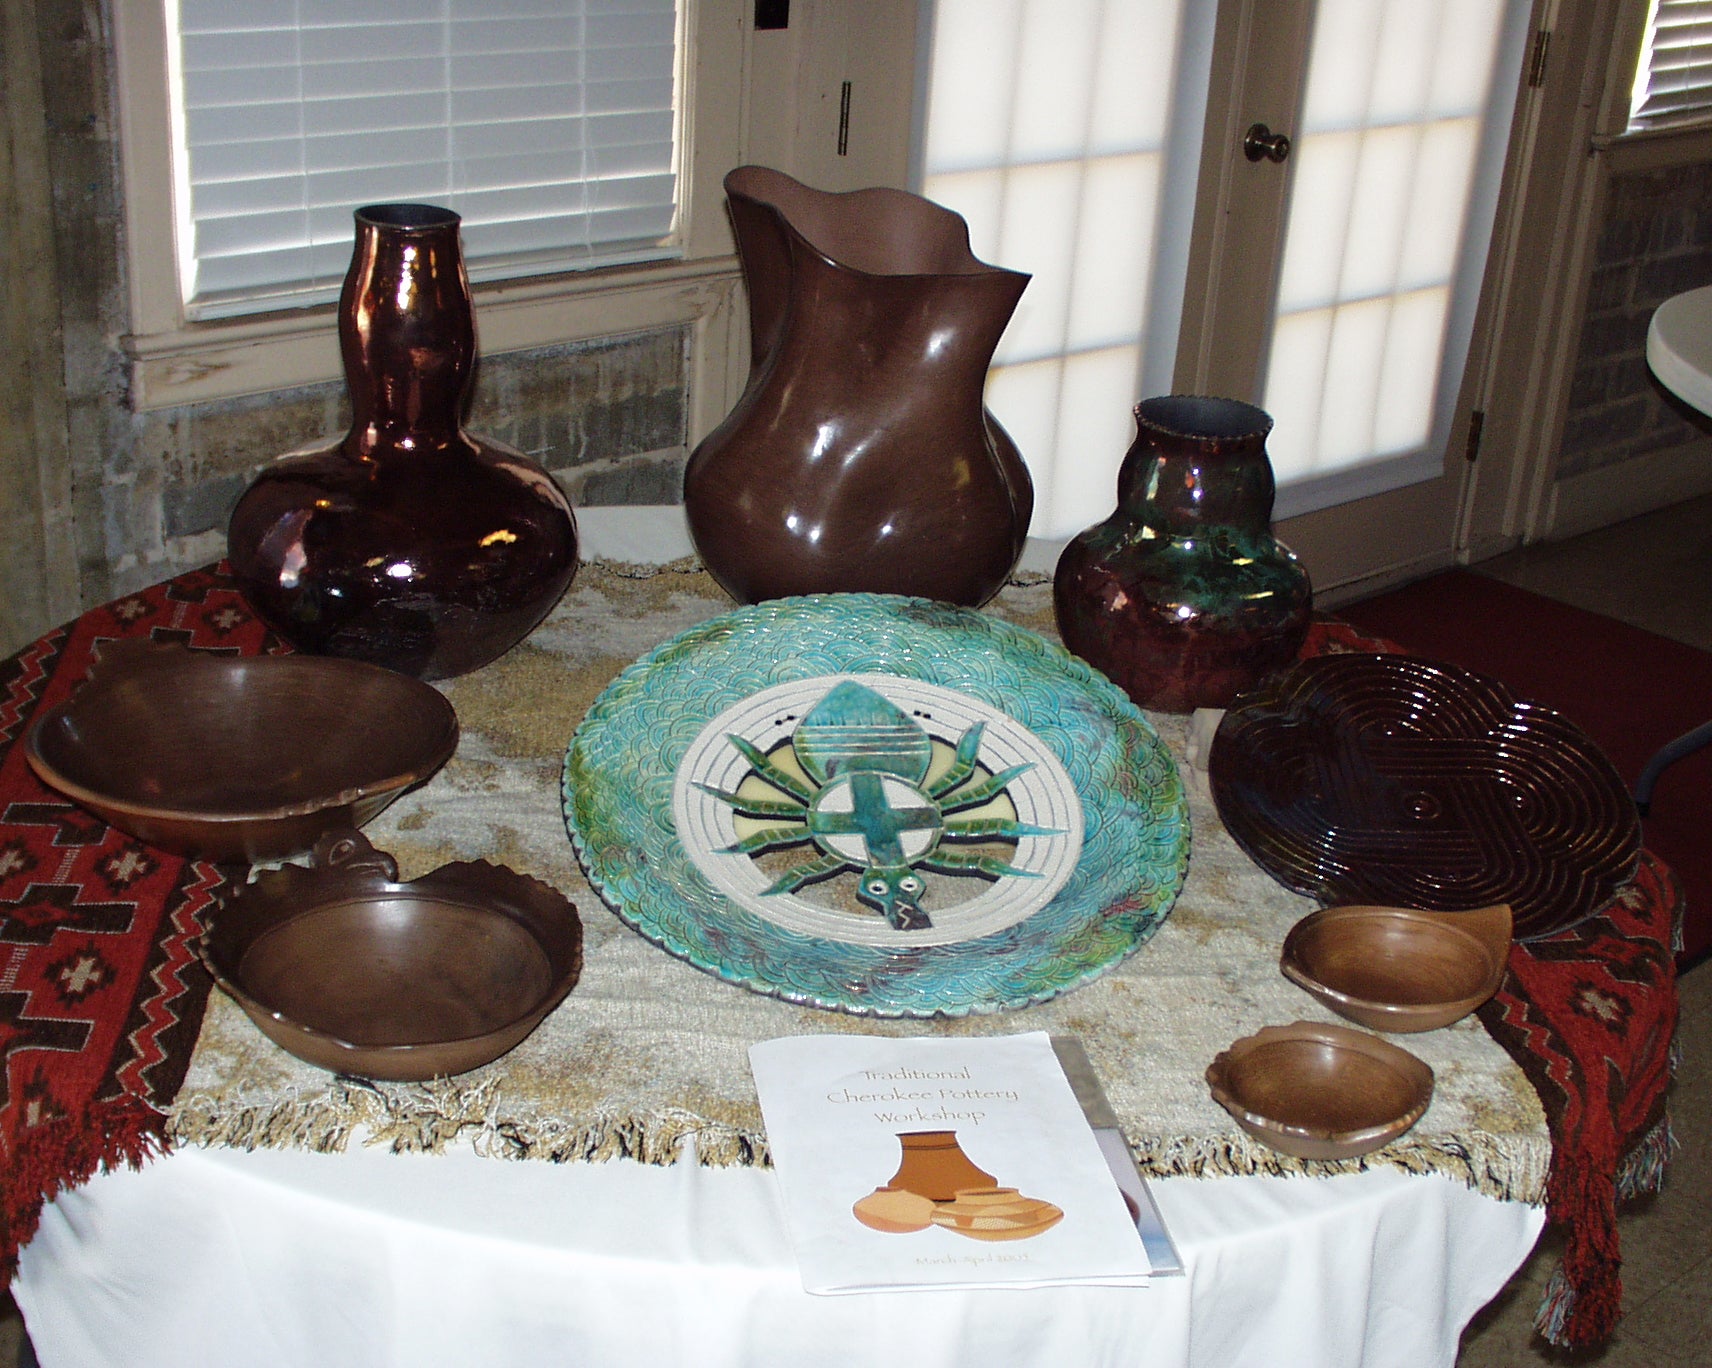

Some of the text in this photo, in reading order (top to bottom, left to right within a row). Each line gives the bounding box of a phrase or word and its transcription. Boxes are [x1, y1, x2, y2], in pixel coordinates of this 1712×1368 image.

[862, 1066, 971, 1081] Traditional
[827, 1087, 1019, 1104] Cherokee Pottery
[874, 1106, 985, 1126] Workshop
